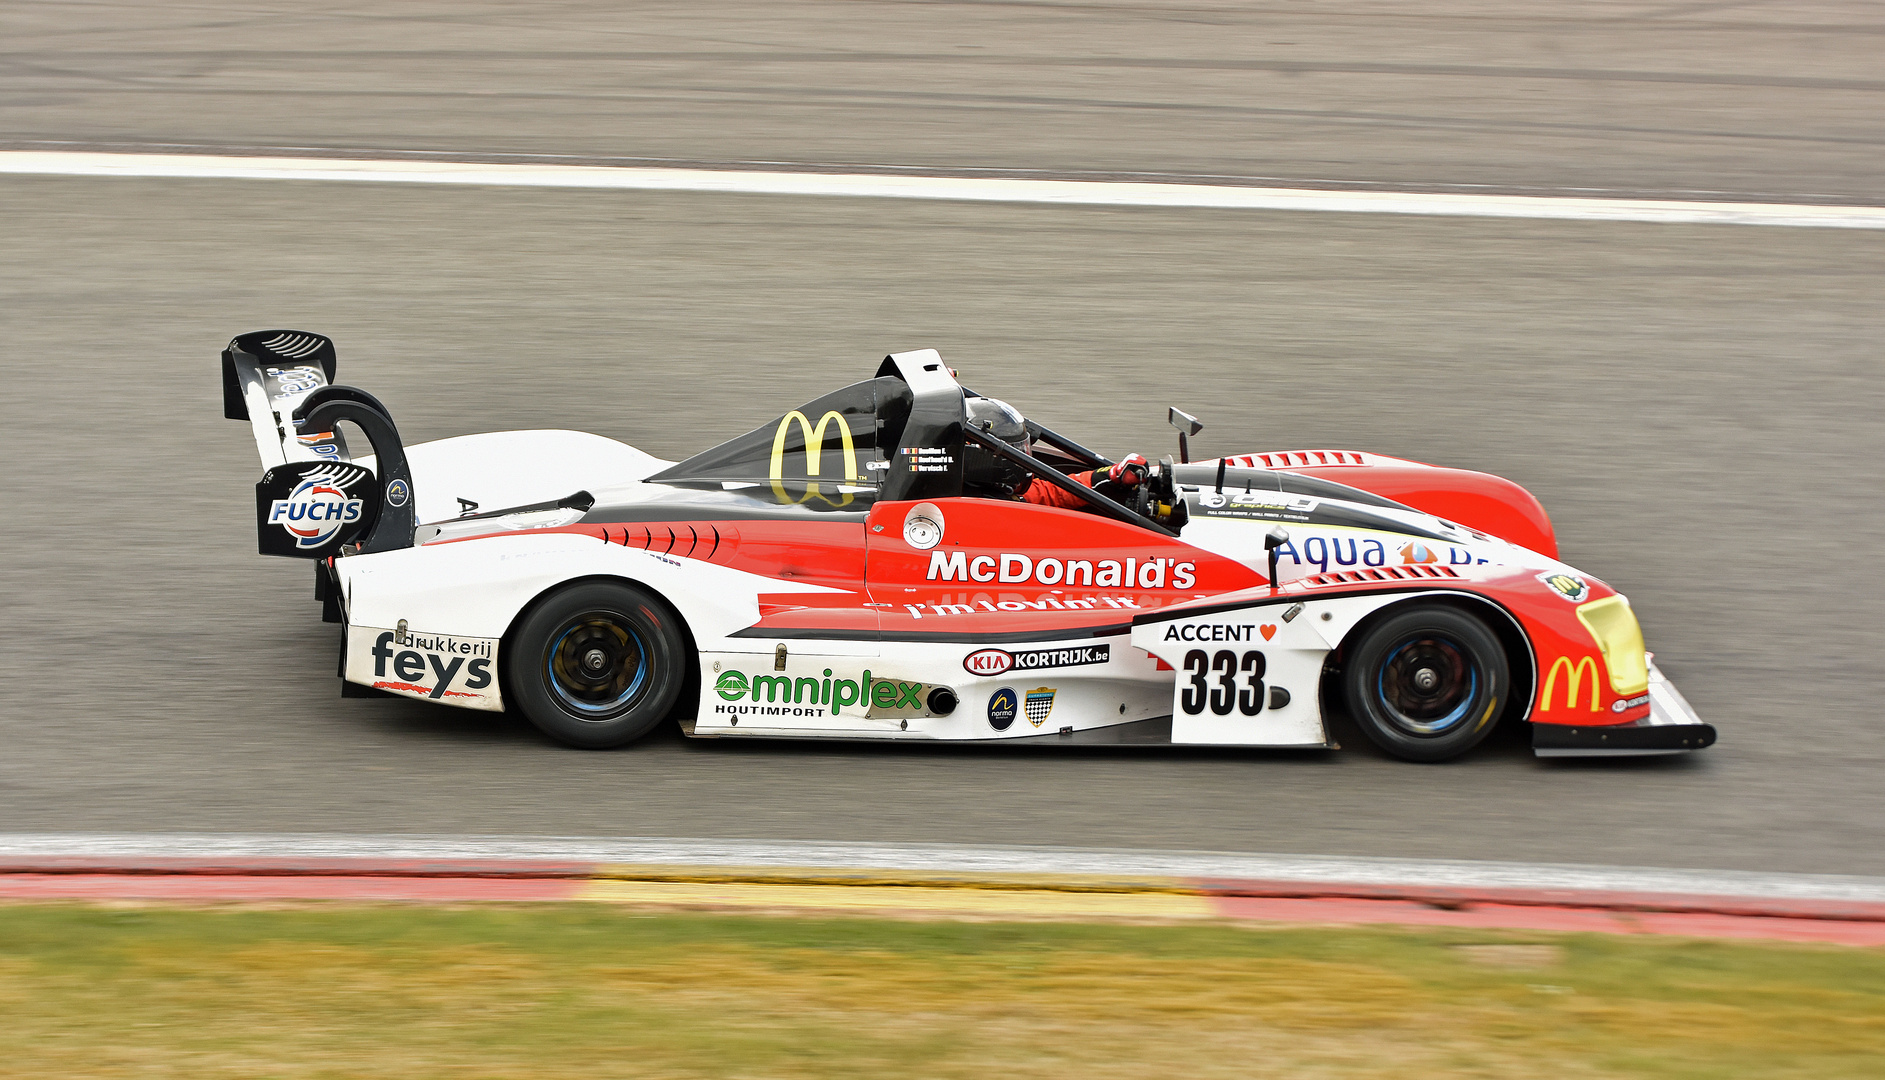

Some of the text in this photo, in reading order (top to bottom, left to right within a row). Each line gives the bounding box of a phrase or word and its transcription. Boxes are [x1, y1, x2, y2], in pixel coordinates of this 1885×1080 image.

[272, 502, 360, 521] FUCHS
[1274, 536, 1385, 573] Aqua
[926, 550, 1196, 589] McDonald's
[1102, 597, 1142, 609] it
[1164, 625, 1255, 641] ACCENT
[404, 634, 492, 658] drukkerij
[372, 632, 492, 699] feys
[973, 655, 1005, 669] KIA
[1182, 649, 1266, 716] 333
[715, 705, 825, 717] HOUTIMPORT
